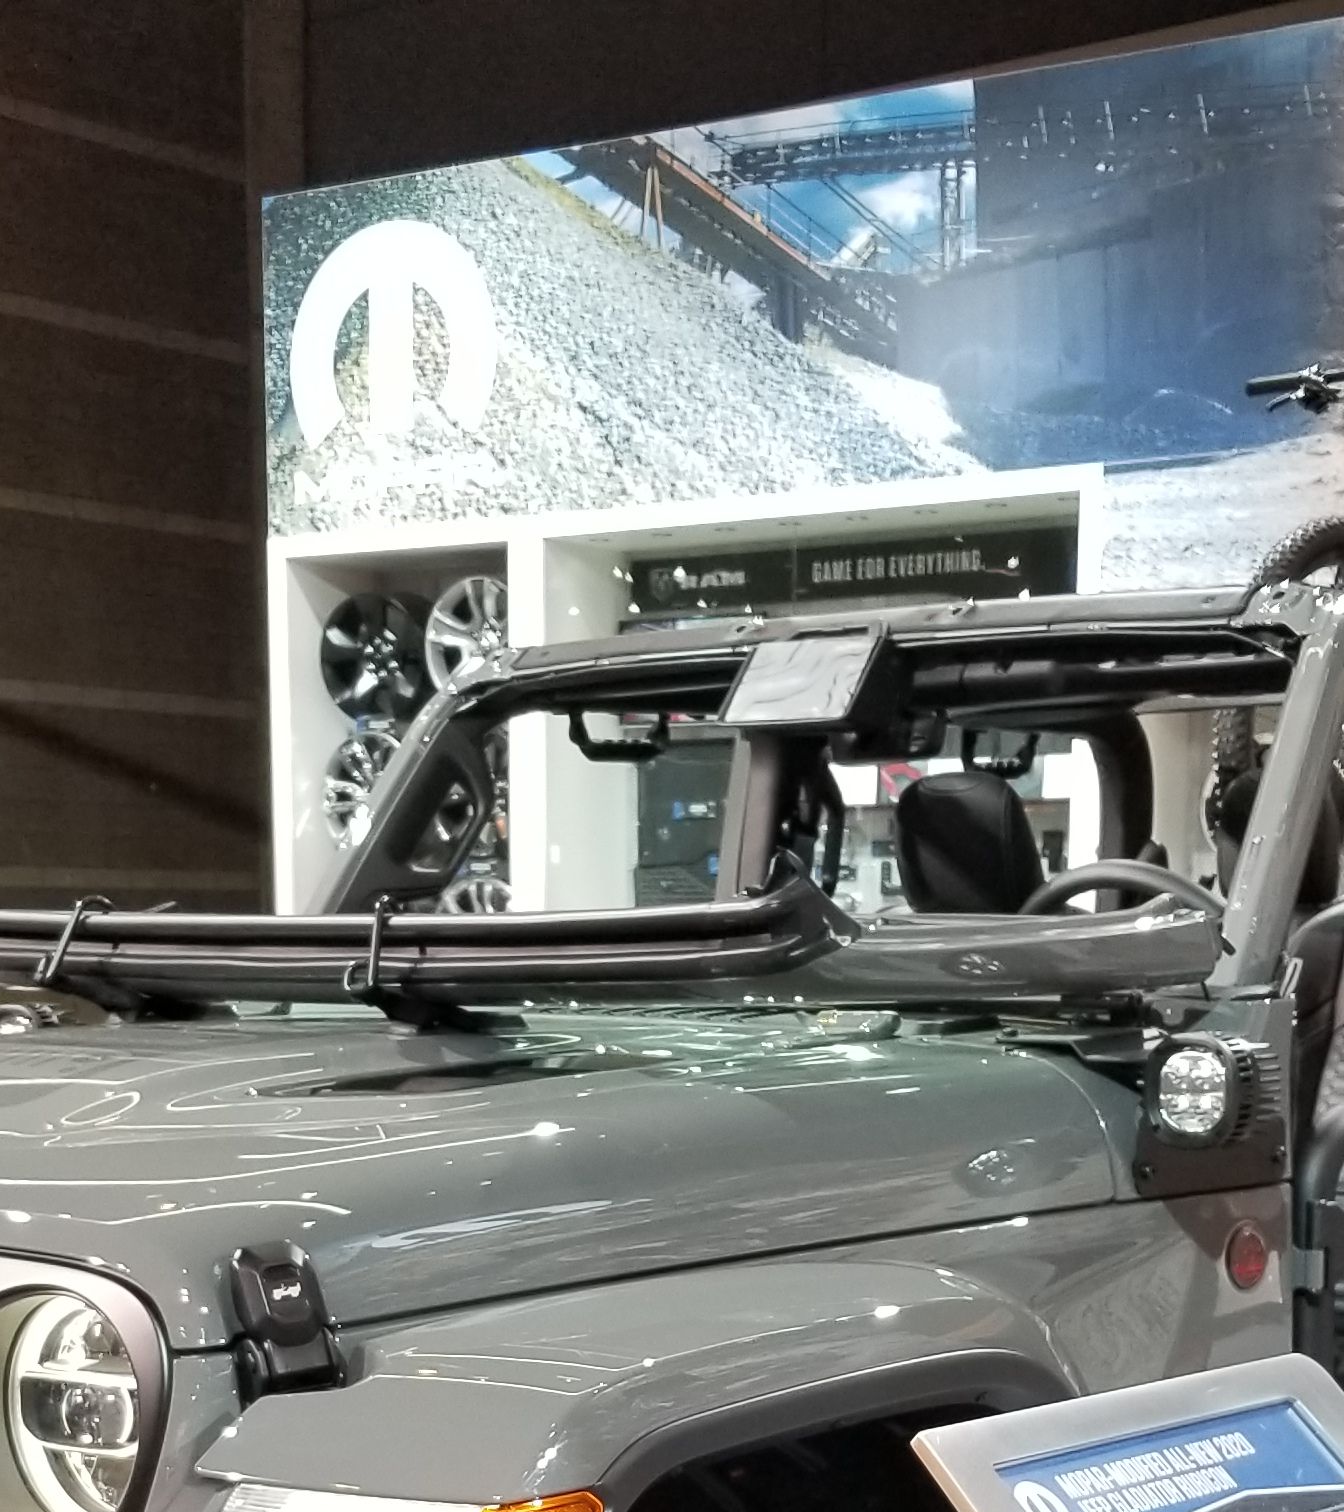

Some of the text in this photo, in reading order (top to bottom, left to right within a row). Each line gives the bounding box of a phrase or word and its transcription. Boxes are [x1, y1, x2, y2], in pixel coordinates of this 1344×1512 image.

[812, 560, 853, 583] GAME
[858, 557, 886, 581] FOR
[1054, 1431, 1256, 1499] MOPAR-MODIFIED ALL-NEW 2020
[1172, 1465, 1238, 1500] RUBICON
